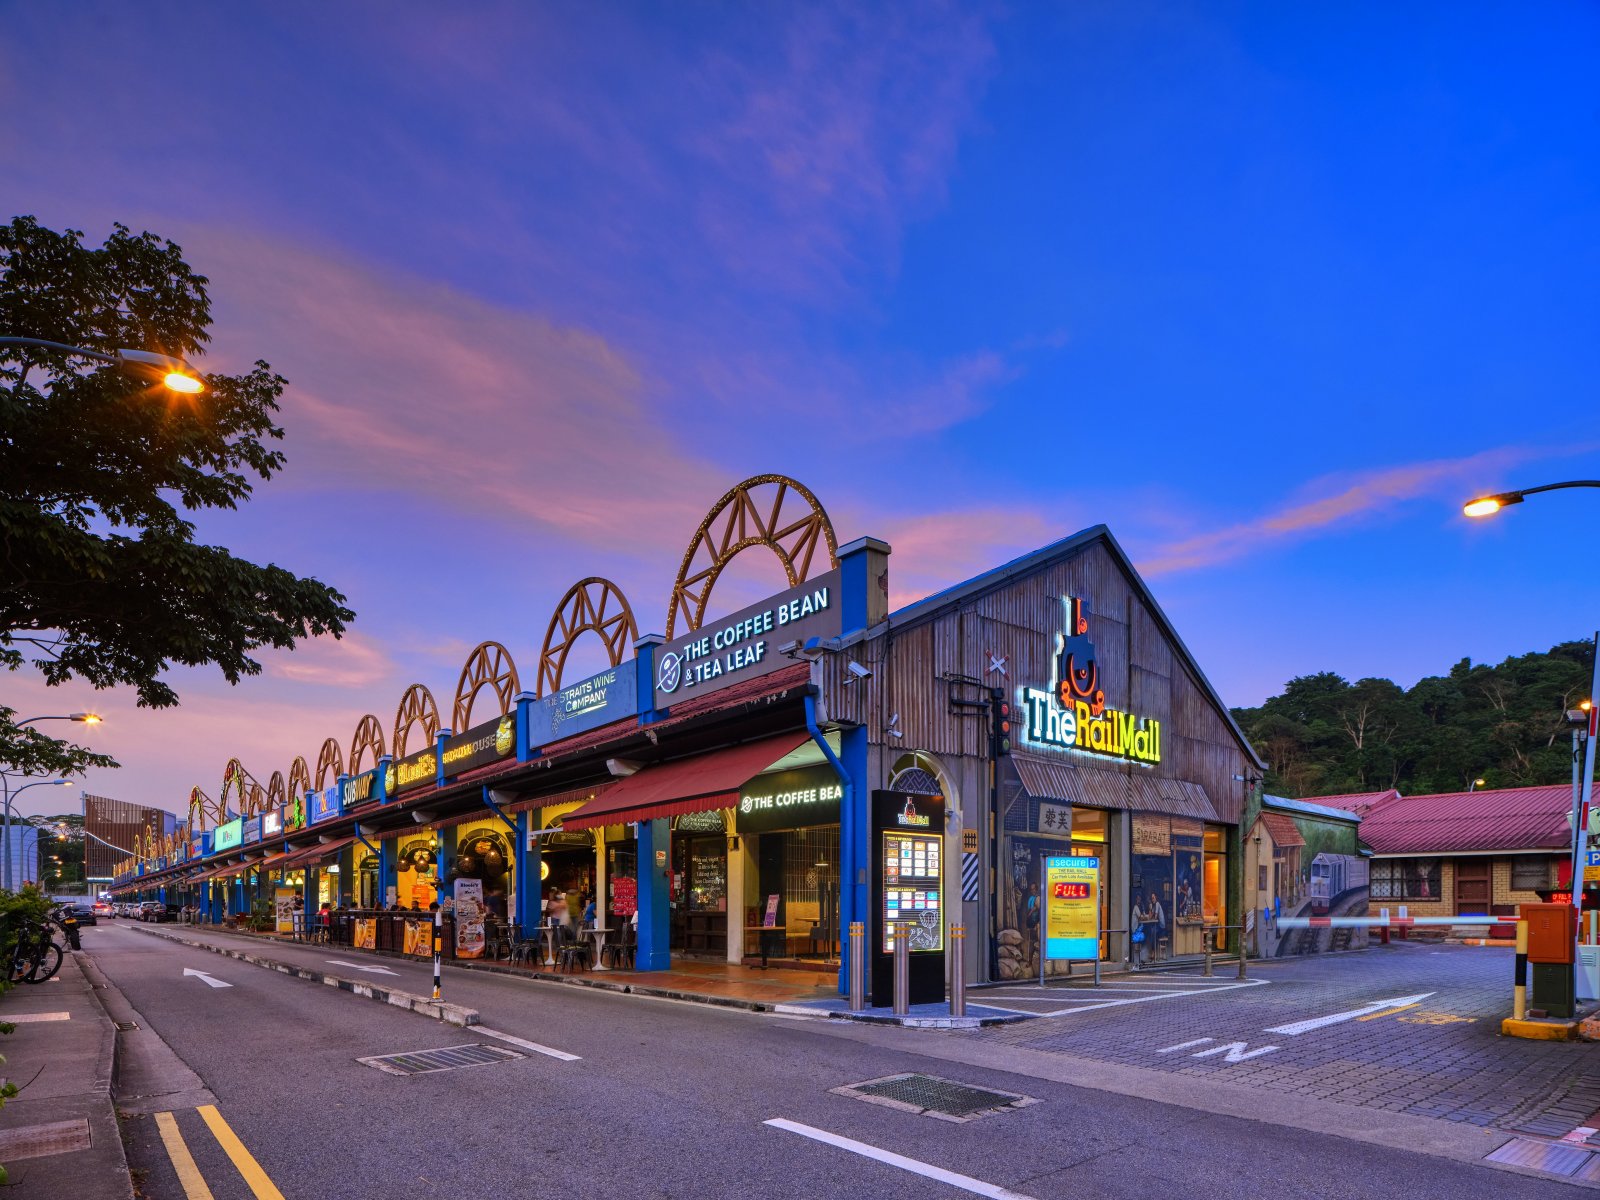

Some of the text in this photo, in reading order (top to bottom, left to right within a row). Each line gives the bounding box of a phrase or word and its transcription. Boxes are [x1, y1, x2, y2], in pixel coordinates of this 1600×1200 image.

[684, 587, 829, 662] THE COFFEE BEAN
[696, 660, 723, 683] TEA
[727, 641, 765, 672] LEAF
[560, 682, 592, 704] STRAITS
[593, 672, 616, 689] WINE
[565, 688, 607, 712] COMPANY
[343, 773, 374, 806] SUBWAY
[754, 796, 773, 808] THE
[776, 790, 816, 806] COFFEE
[1055, 858, 1086, 868] secure
[1054, 884, 1087, 897] FULL
